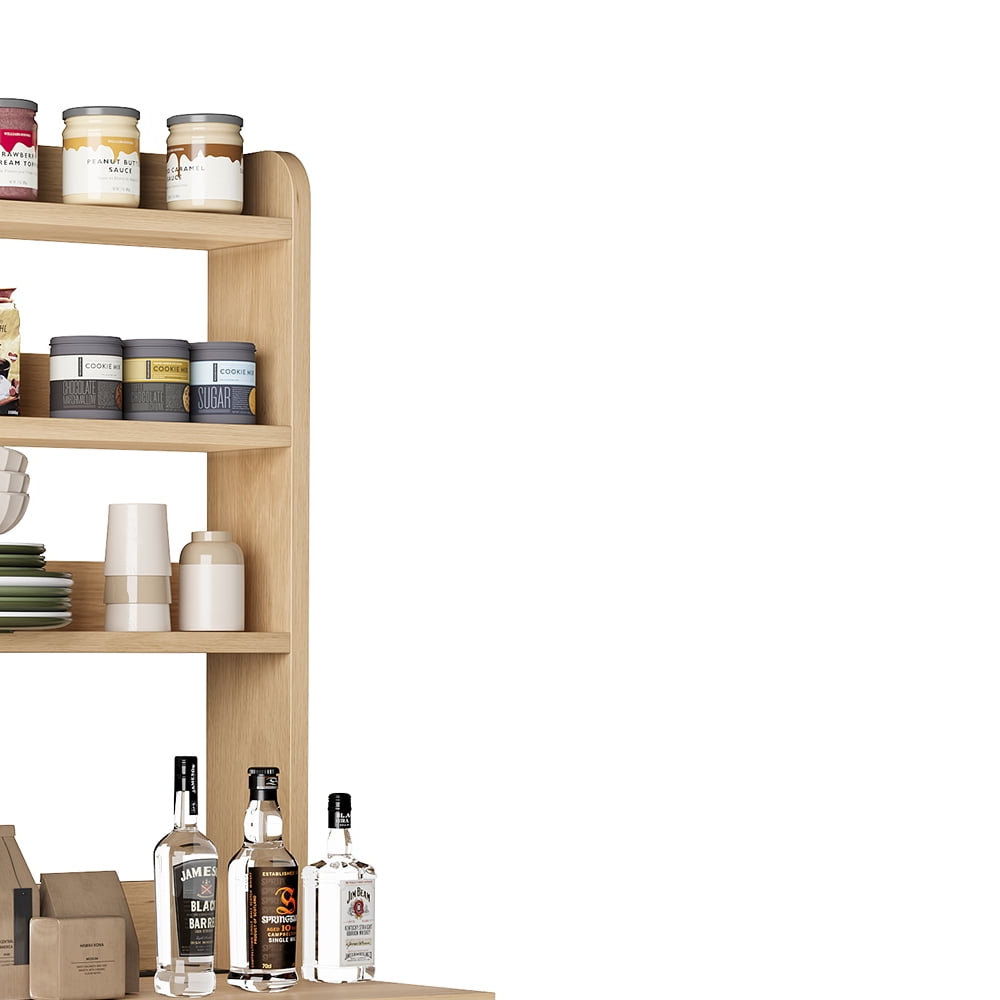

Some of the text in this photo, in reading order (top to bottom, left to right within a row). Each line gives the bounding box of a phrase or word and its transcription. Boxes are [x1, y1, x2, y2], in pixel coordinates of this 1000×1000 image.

[85, 362, 112, 370] COOKIE
[153, 365, 180, 373] COOKIE
[198, 386, 231, 409] SUGAR
[181, 865, 217, 882] JAMES
[346, 887, 370, 904] JIM BEAM
[281, 924, 291, 932] 10
